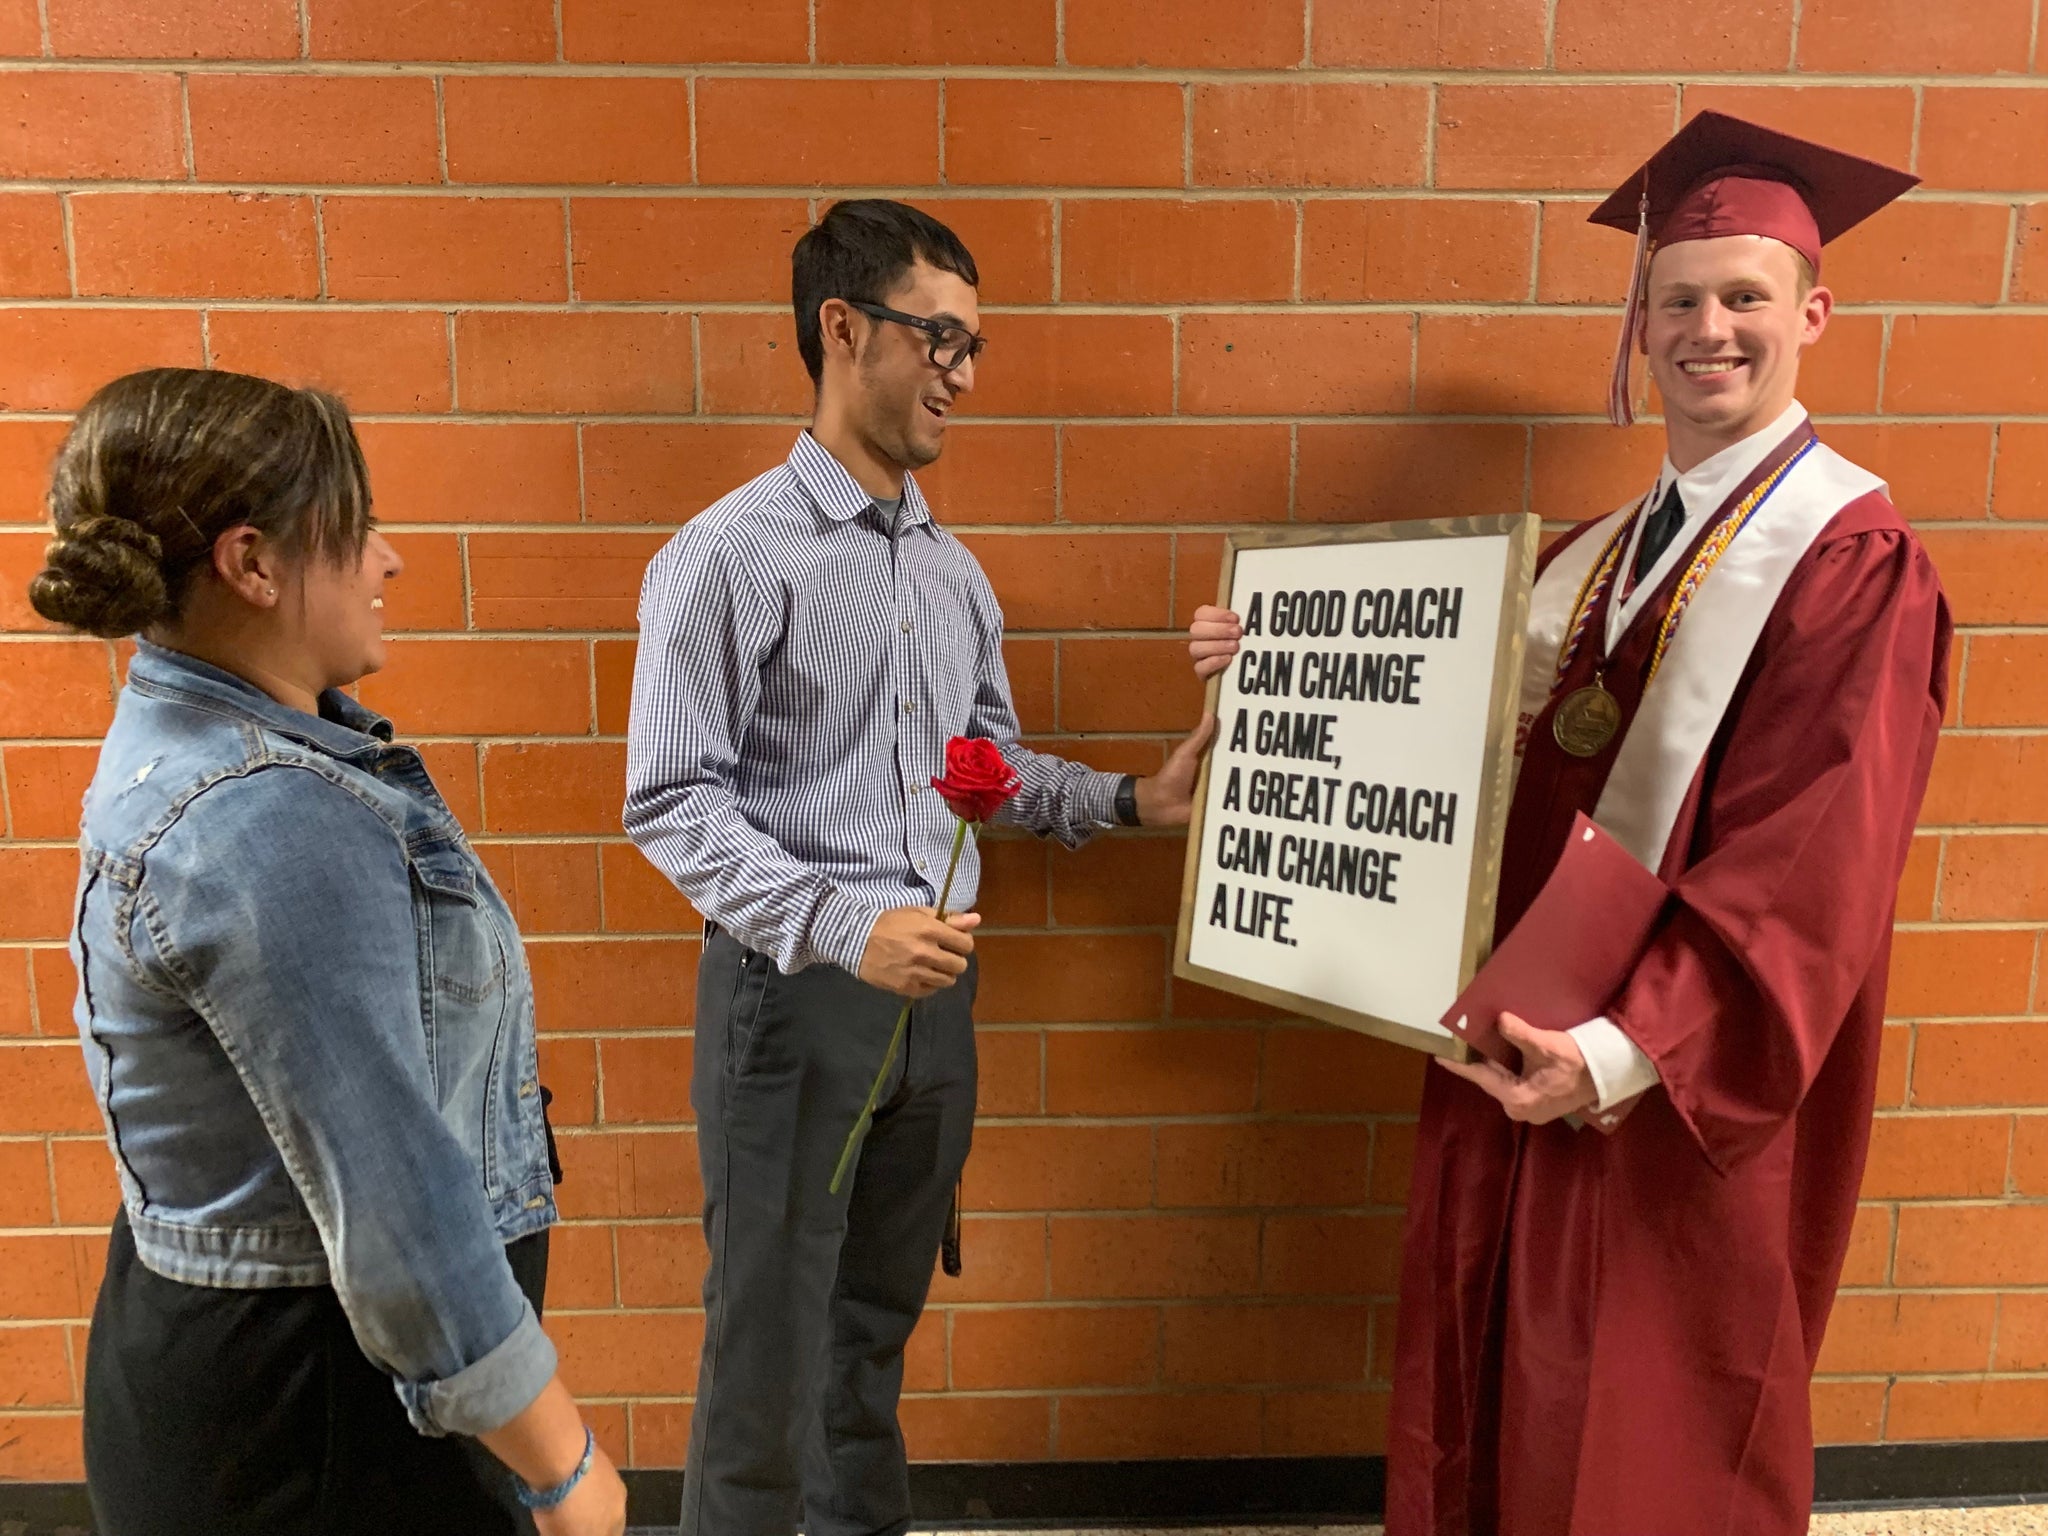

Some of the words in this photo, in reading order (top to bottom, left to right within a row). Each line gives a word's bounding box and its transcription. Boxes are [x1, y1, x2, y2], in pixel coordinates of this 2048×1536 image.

[1243, 591, 1262, 637] A
[1269, 589, 1346, 638] GOOD
[1352, 587, 1463, 639] COACH
[1238, 650, 1295, 697] CAN
[1299, 652, 1425, 704] CHANGE
[1229, 708, 1248, 753] A
[1255, 710, 1341, 769] GAME,
[1222, 767, 1241, 812] A
[1248, 770, 1342, 826] GREAT
[1346, 781, 1458, 845] COACH
[1217, 824, 1273, 878] CAN
[1278, 834, 1401, 904] CHANGE
[1209, 883, 1227, 929] A
[1234, 888, 1297, 947] LIFE.
